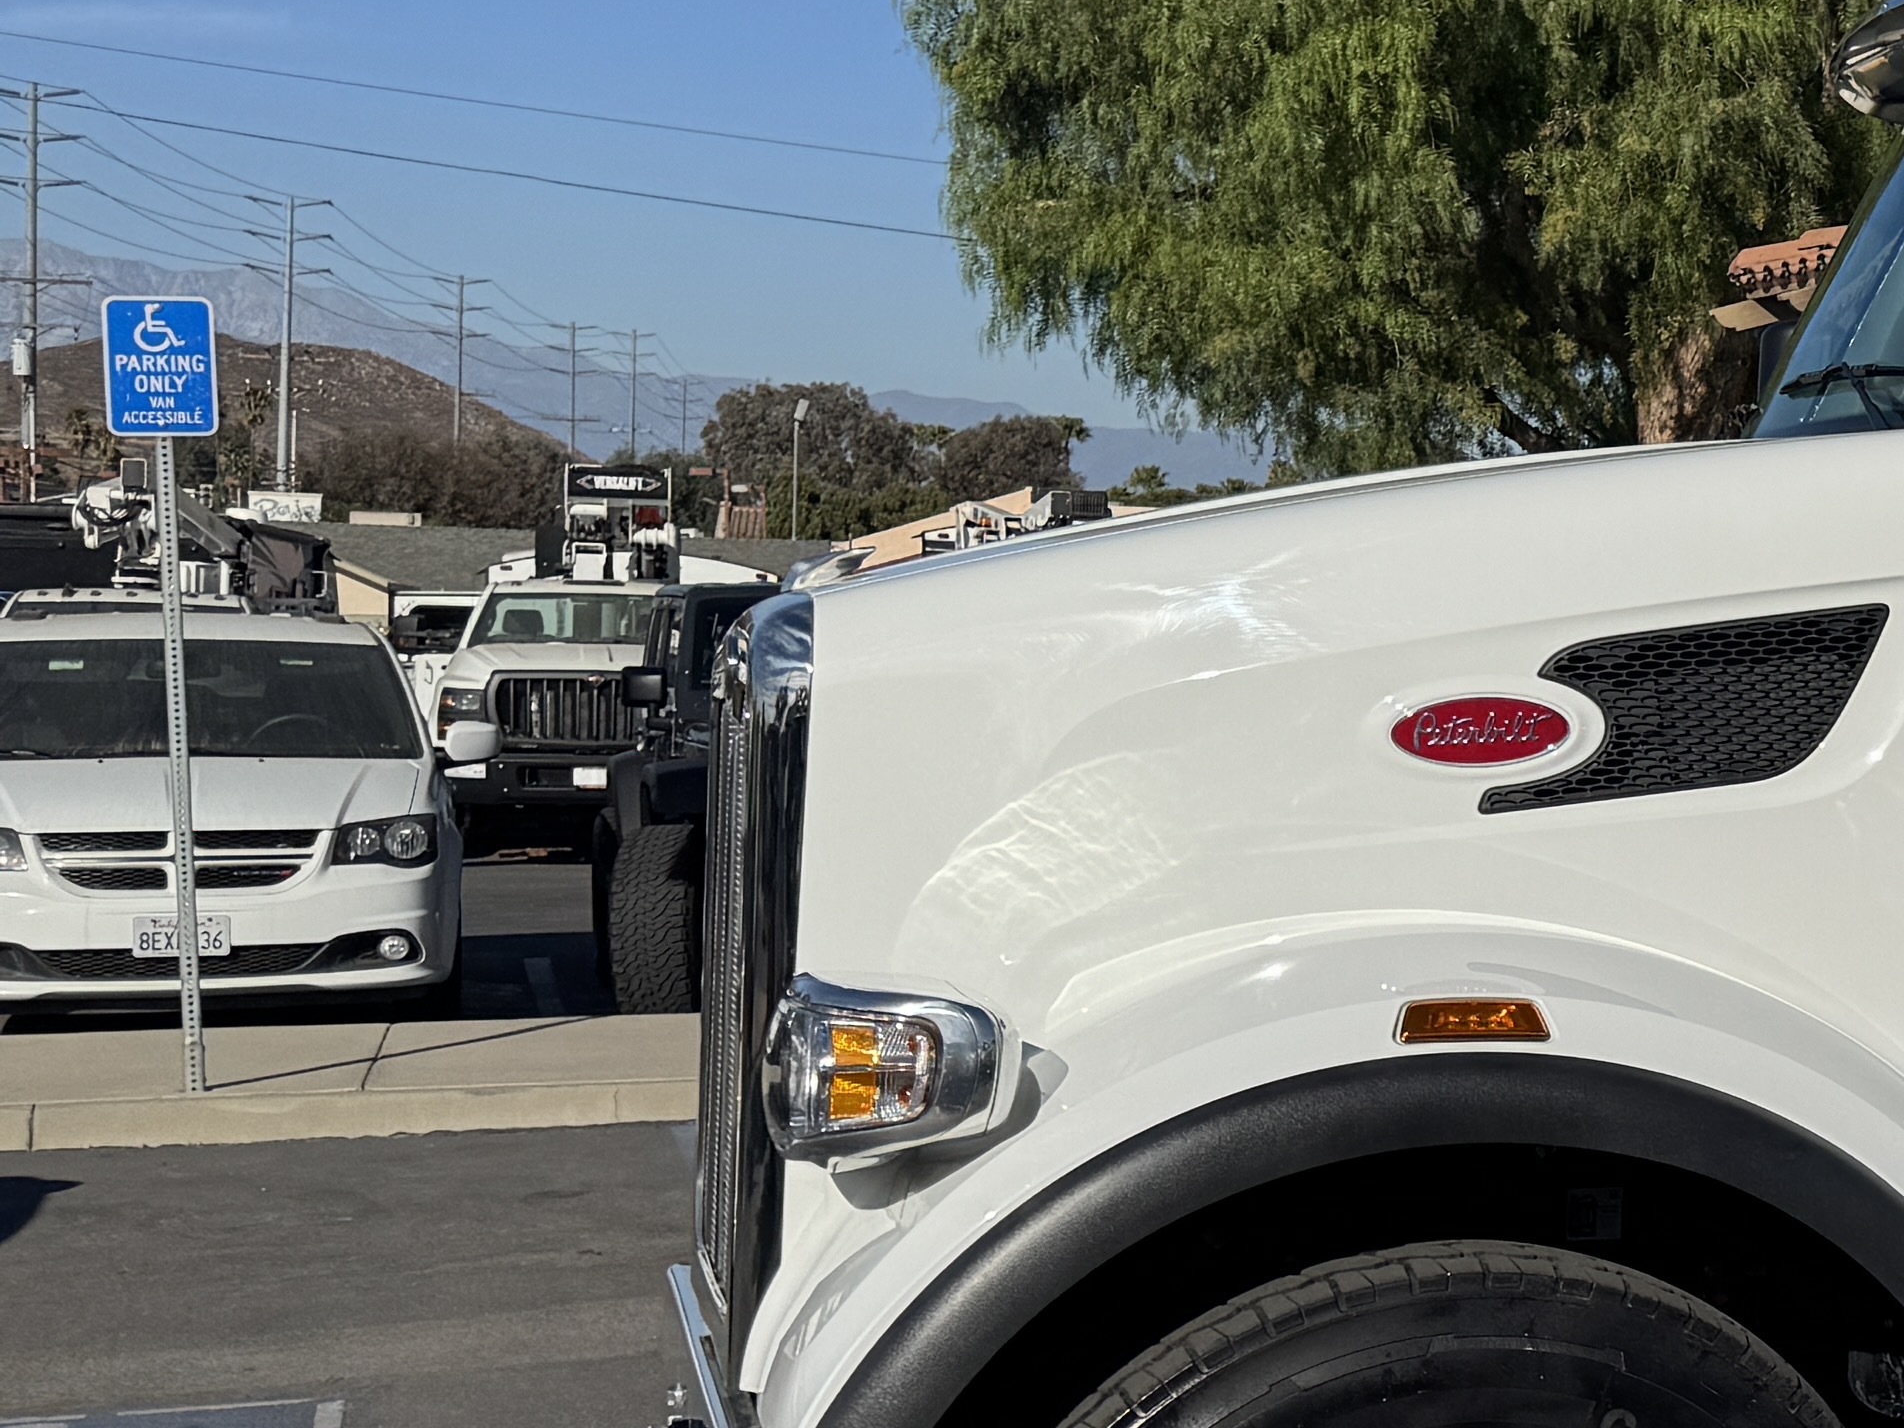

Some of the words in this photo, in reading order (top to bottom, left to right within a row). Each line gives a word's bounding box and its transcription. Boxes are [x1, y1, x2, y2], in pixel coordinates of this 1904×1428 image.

[115, 355, 205, 372] PARKING
[134, 374, 188, 393] ONLY
[149, 396, 175, 408] VAN
[122, 411, 203, 424] ACCESSIBLE
[593, 475, 643, 491] VERSALIFT
[1413, 711, 1554, 751] Peterbilt
[139, 930, 223, 951] 8EX36
